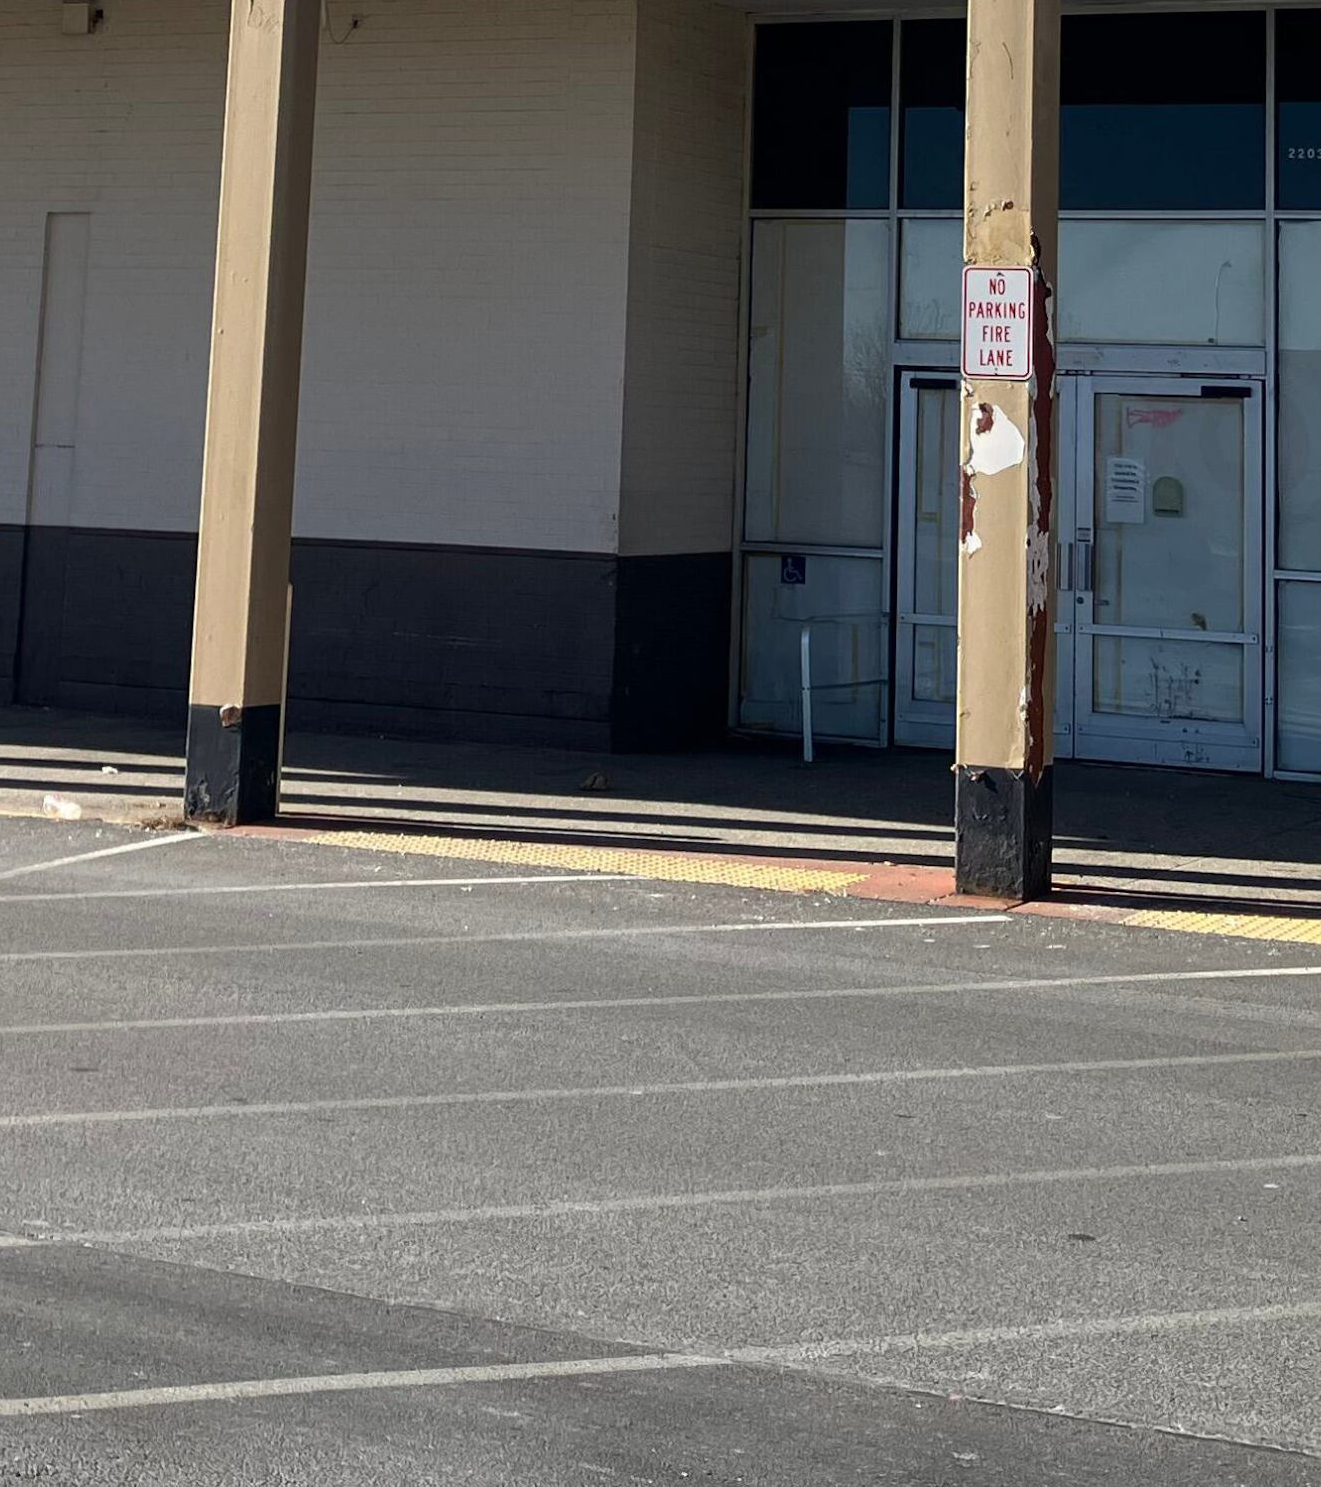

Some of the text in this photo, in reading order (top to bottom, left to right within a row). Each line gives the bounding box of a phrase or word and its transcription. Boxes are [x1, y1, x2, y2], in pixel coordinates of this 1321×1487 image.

[989, 278, 1006, 295] NO
[969, 301, 1025, 319] PARKING
[982, 325, 1011, 342] FIRE
[980, 349, 1013, 366] LANE
